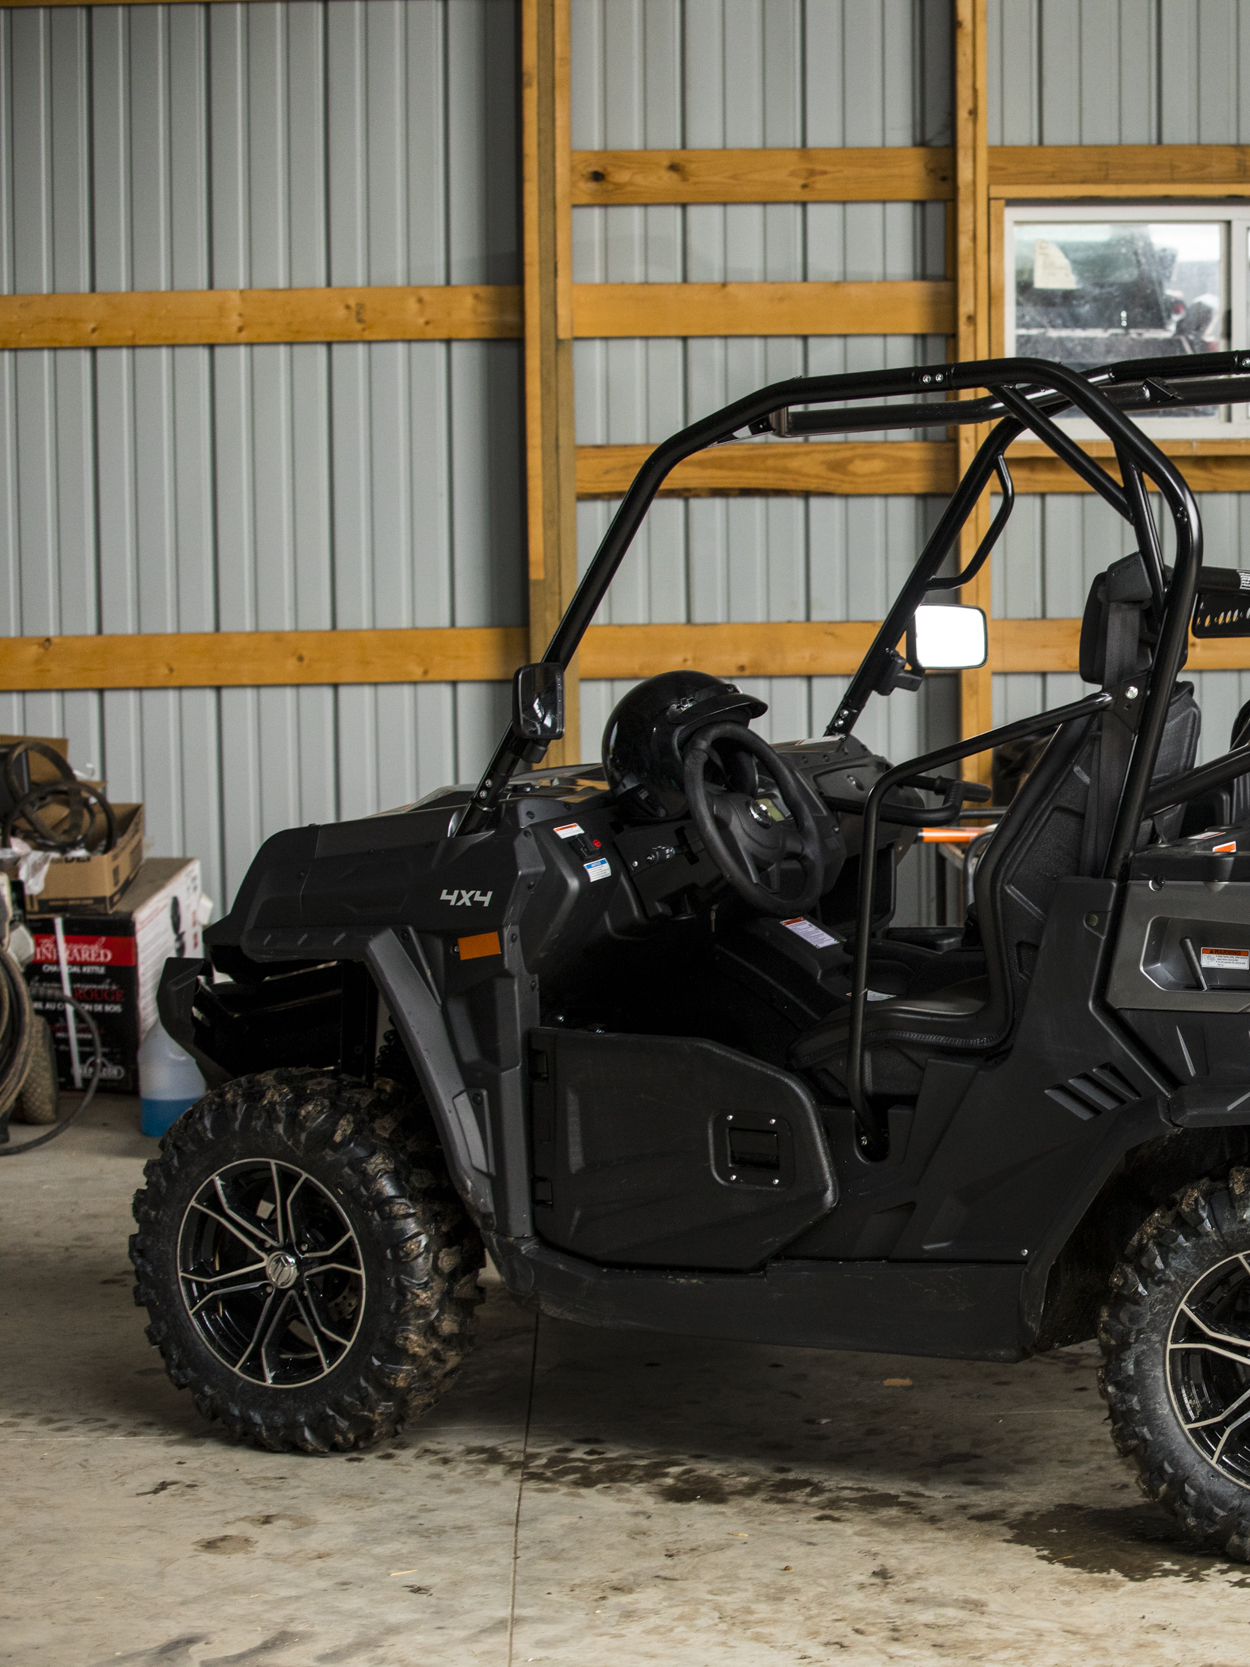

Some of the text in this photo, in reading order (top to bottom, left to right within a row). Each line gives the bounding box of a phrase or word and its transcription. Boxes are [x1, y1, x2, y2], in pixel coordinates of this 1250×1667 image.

[439, 889, 493, 907] 4X4
[35, 946, 112, 962] INARED
[73, 989, 124, 1002] ROUGE
